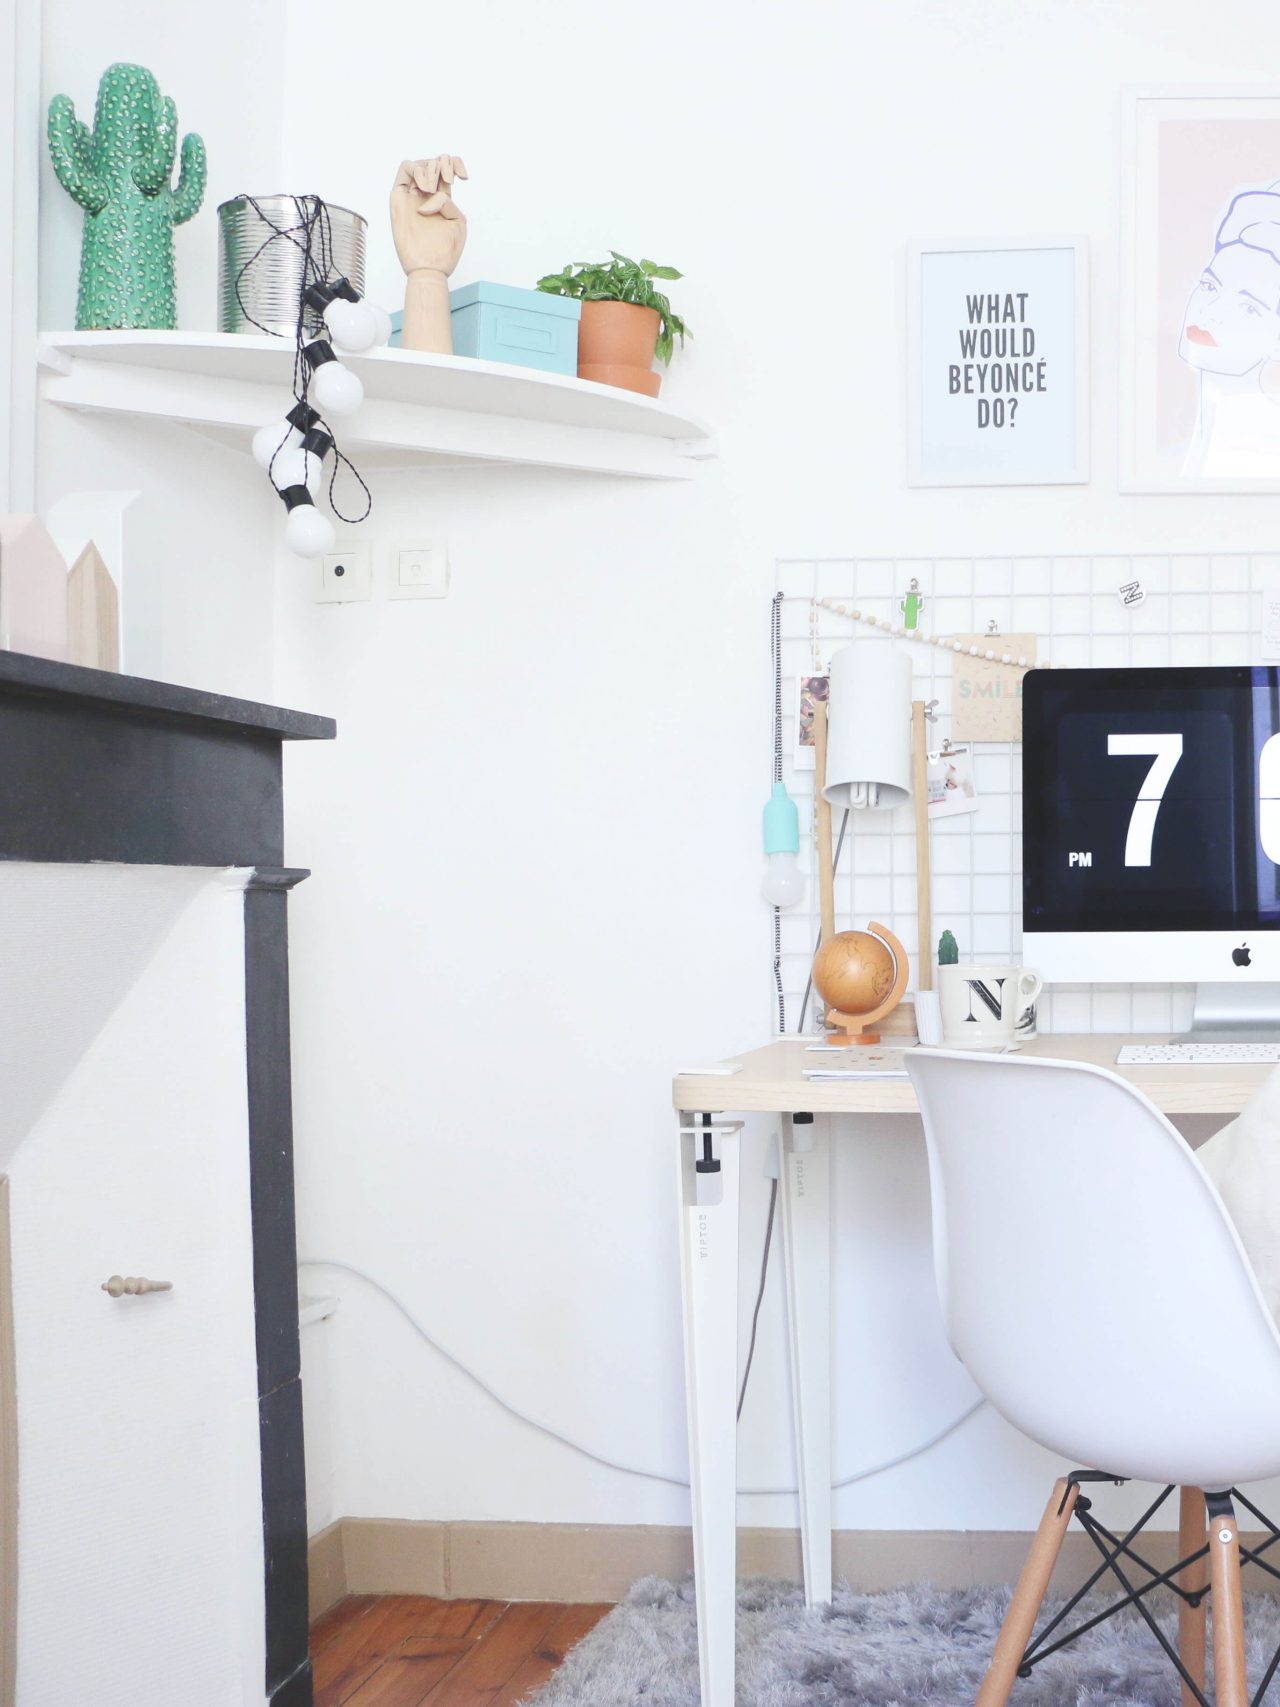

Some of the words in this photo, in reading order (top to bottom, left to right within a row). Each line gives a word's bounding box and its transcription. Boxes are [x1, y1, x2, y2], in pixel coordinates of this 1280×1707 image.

[966, 293, 1028, 324] WHAT
[959, 327, 1035, 359] WOULD
[948, 357, 1047, 394] BEYONCÉ
[977, 397, 1018, 429] DO?
[1107, 733, 1183, 867] 7
[1068, 852, 1092, 867] PM
[963, 978, 1006, 1022] N
